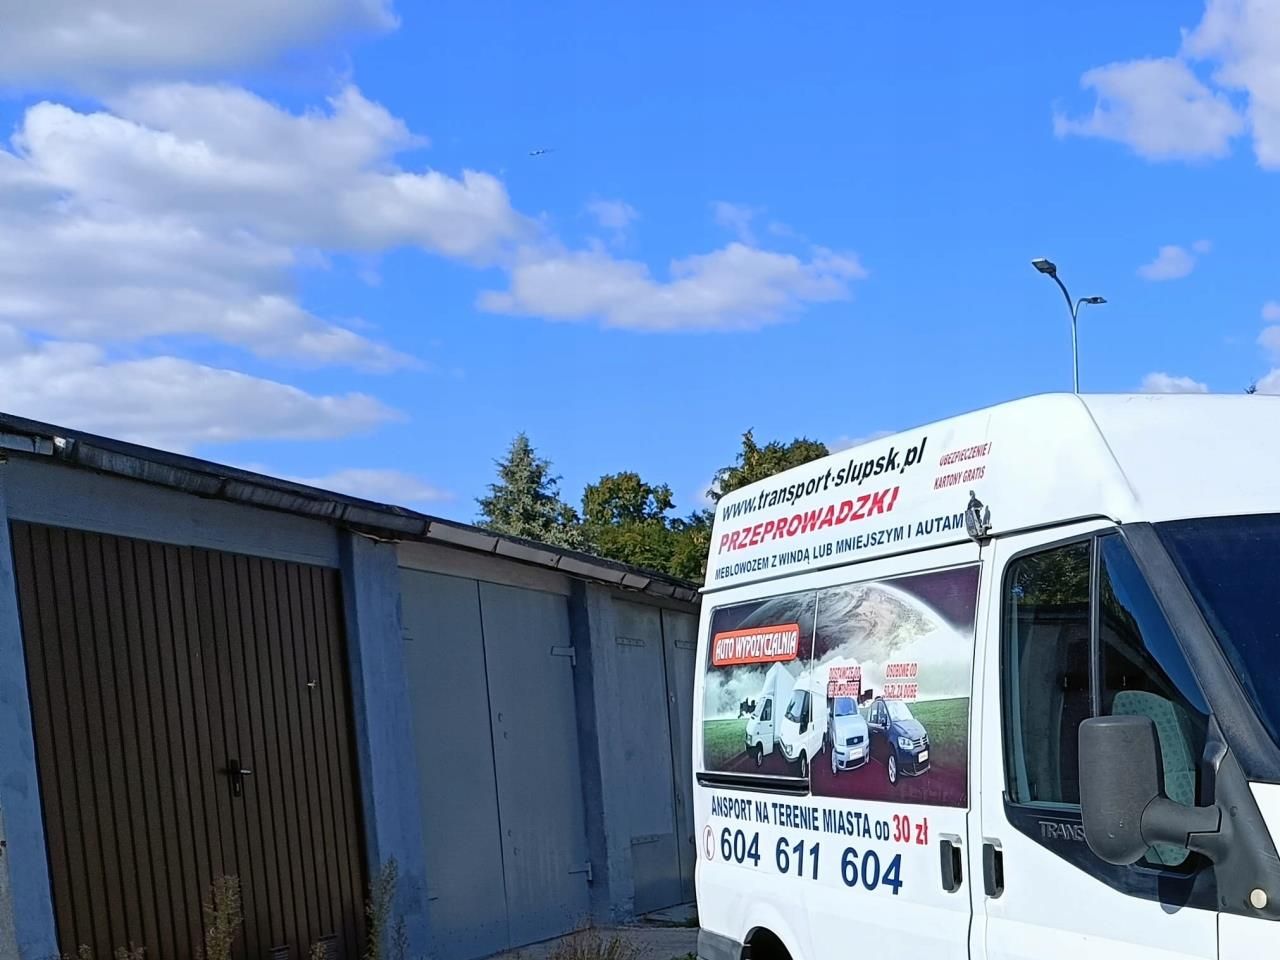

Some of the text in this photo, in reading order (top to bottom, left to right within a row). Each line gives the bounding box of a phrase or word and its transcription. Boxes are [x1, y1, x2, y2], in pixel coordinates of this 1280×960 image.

[933, 465, 986, 491] KARTONY GRATIS
[717, 486, 900, 555] PRZEPROWADZKI
[714, 556, 769, 580] MEBLOWOZEM
[812, 542, 833, 560] LUB
[834, 525, 904, 555] MNIEJSZYM
[915, 512, 965, 537] AUTAM
[715, 637, 735, 661] AUTO
[755, 800, 770, 824] NA
[771, 802, 820, 831] TERENIE
[822, 808, 872, 839] MIASTA
[874, 819, 890, 841] OD
[892, 814, 911, 843] 30
[915, 817, 928, 845] zł
[1038, 821, 1085, 841] TRANS
[720, 827, 903, 896] 604 611 604
